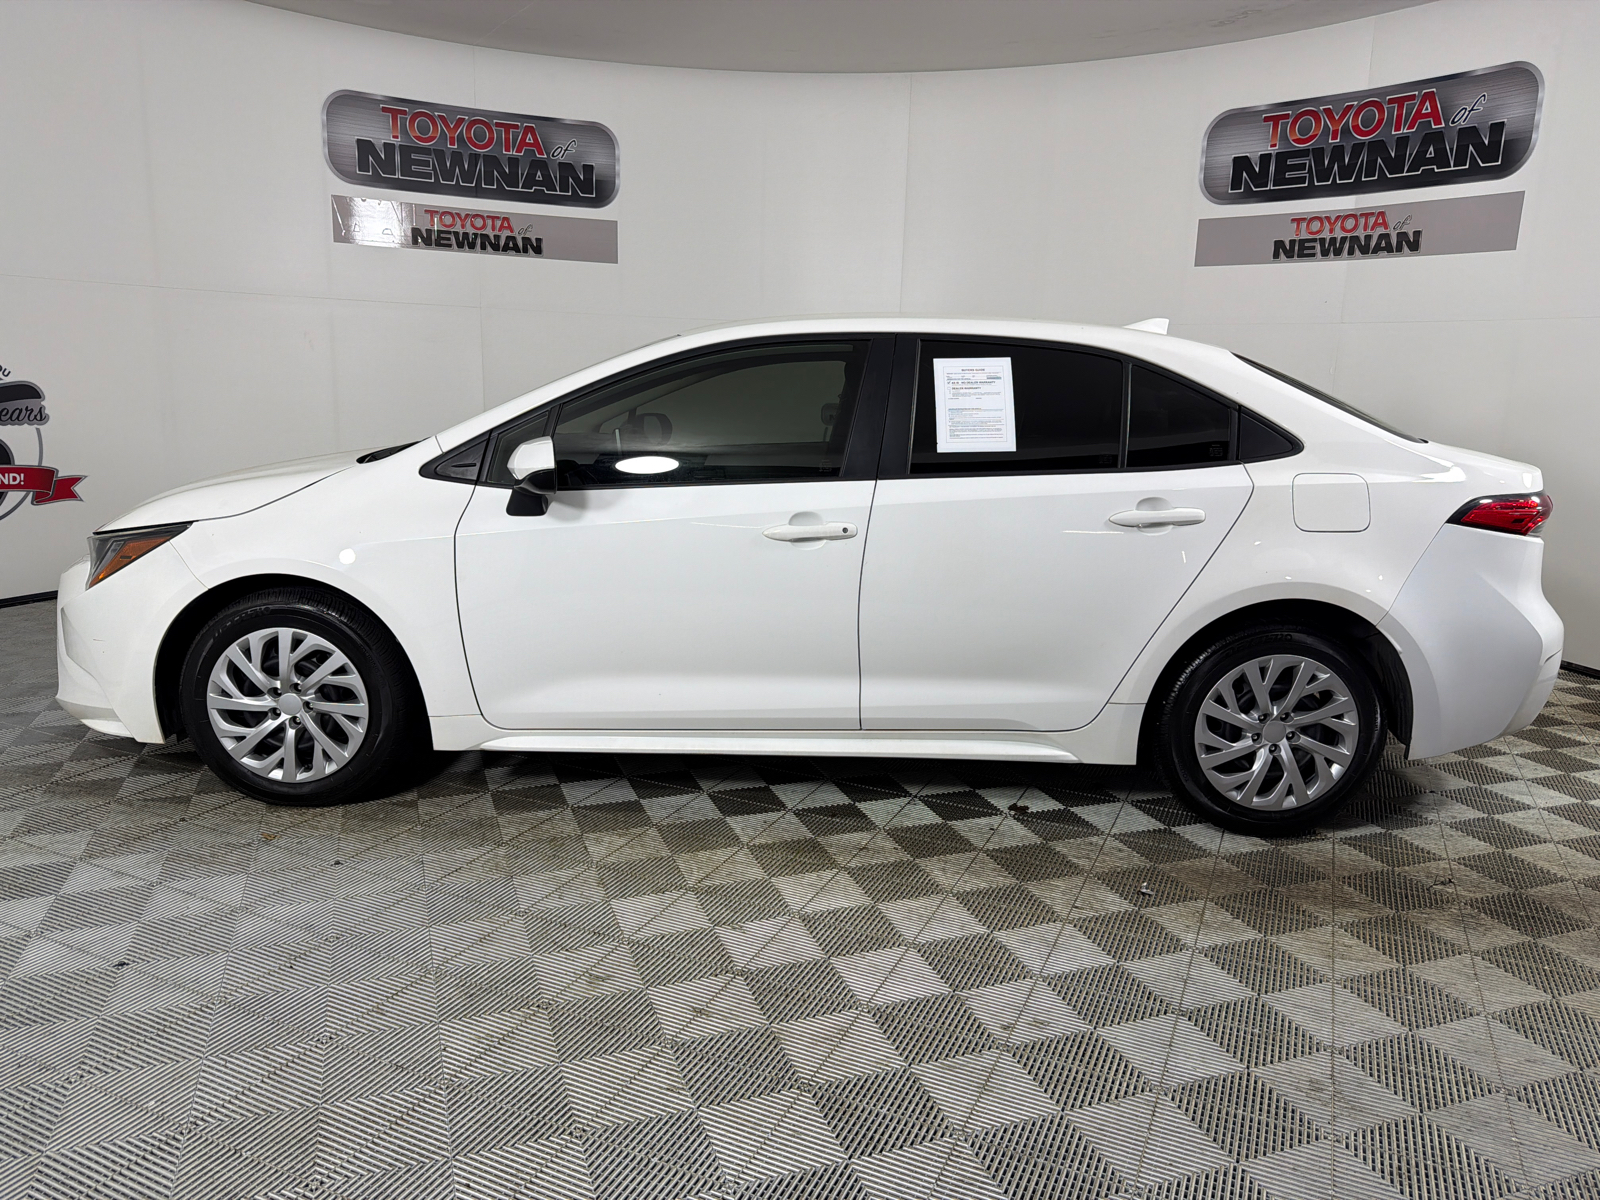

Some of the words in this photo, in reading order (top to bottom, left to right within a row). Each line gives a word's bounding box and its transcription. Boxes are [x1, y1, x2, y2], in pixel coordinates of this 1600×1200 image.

[379, 104, 547, 157] TOYOTA
[550, 139, 578, 159] of
[1263, 88, 1445, 149] TOYOTA
[1450, 93, 1487, 126] of
[355, 138, 596, 197] NEWNAN
[1228, 119, 1507, 193] NEWNAN
[411, 226, 544, 256] NEWNAN
[424, 209, 514, 234] TOYOTA
[518, 224, 533, 236] of
[1290, 211, 1389, 237] TOYOTA
[1393, 214, 1413, 230] of
[1272, 229, 1422, 261] NEWNAN
